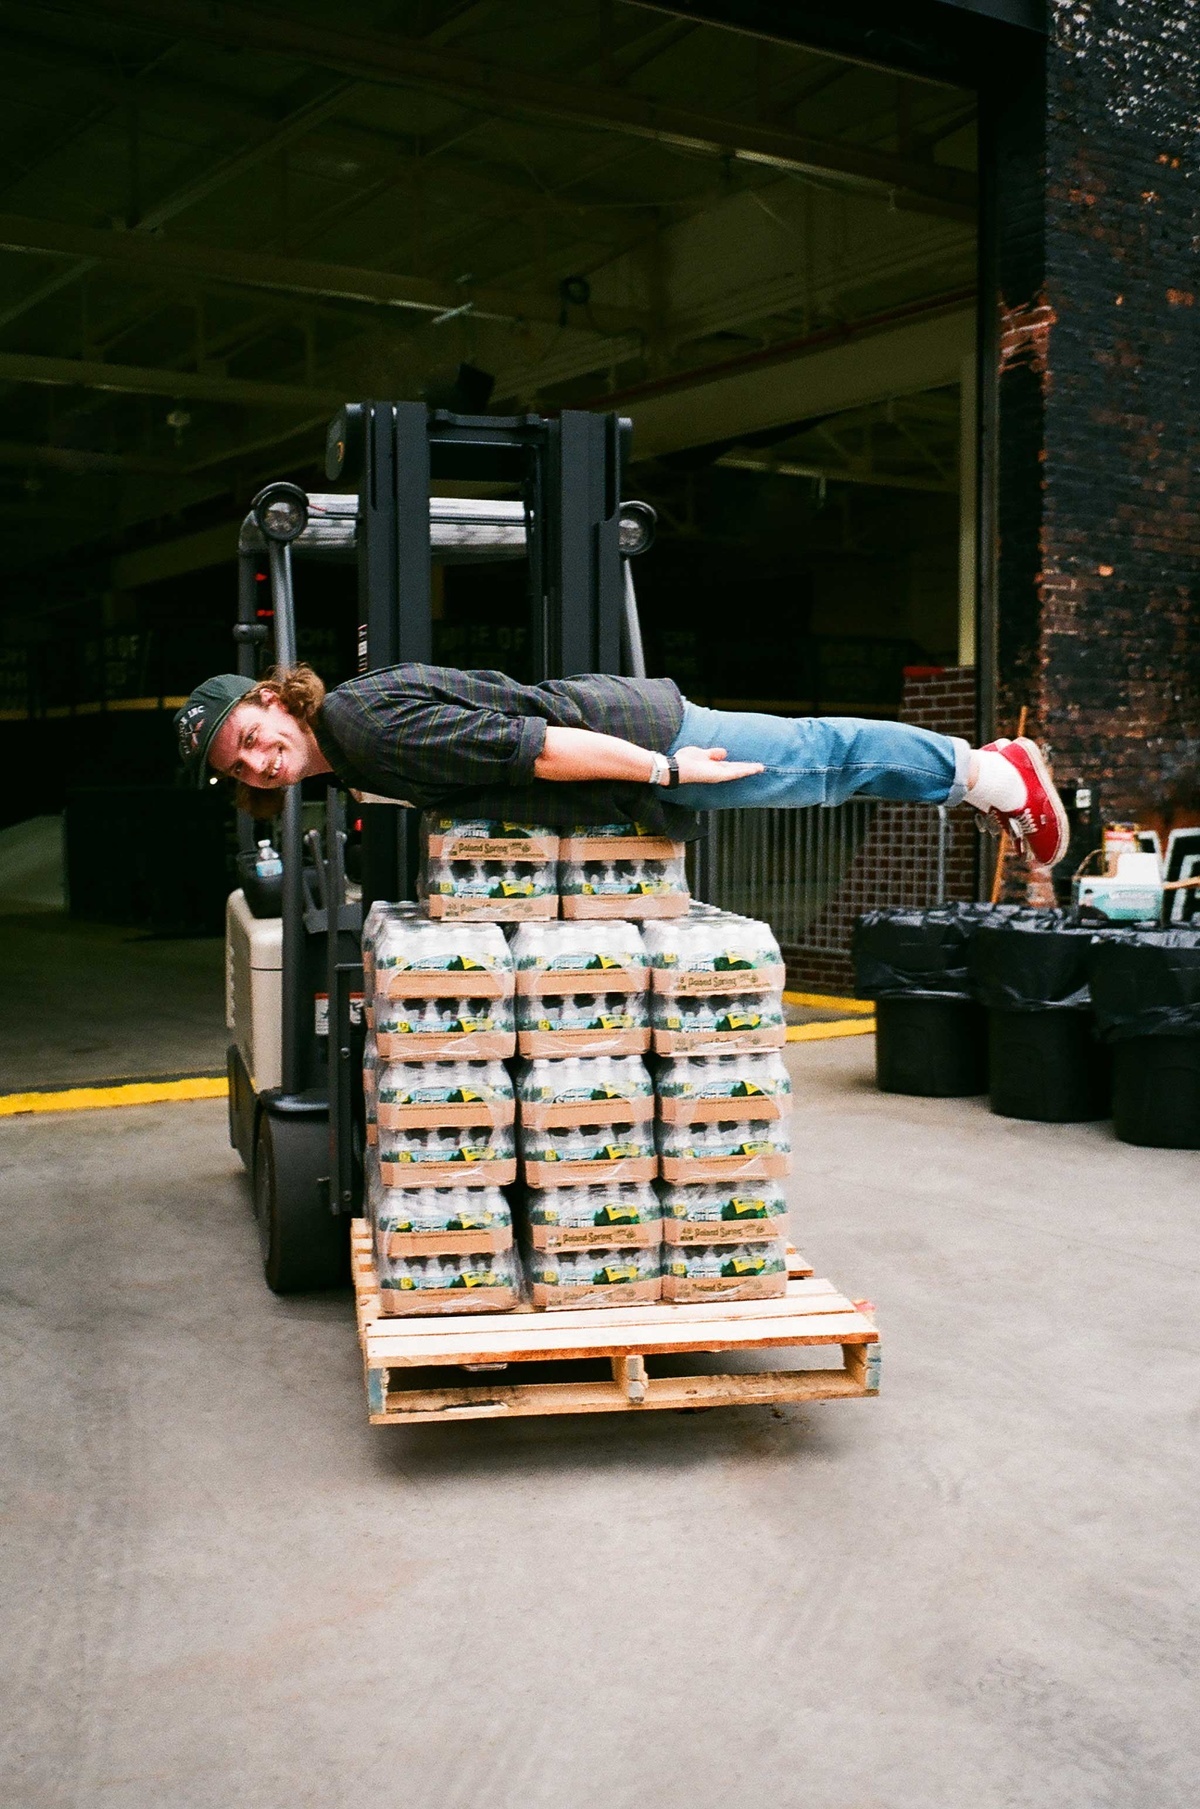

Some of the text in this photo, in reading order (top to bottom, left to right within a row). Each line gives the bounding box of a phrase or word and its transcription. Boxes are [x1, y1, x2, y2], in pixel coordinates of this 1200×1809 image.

[459, 843, 483, 853] Poland
[484, 843, 508, 854] Spring
[563, 1233, 587, 1244] Poland
[588, 1231, 612, 1243] Spring
